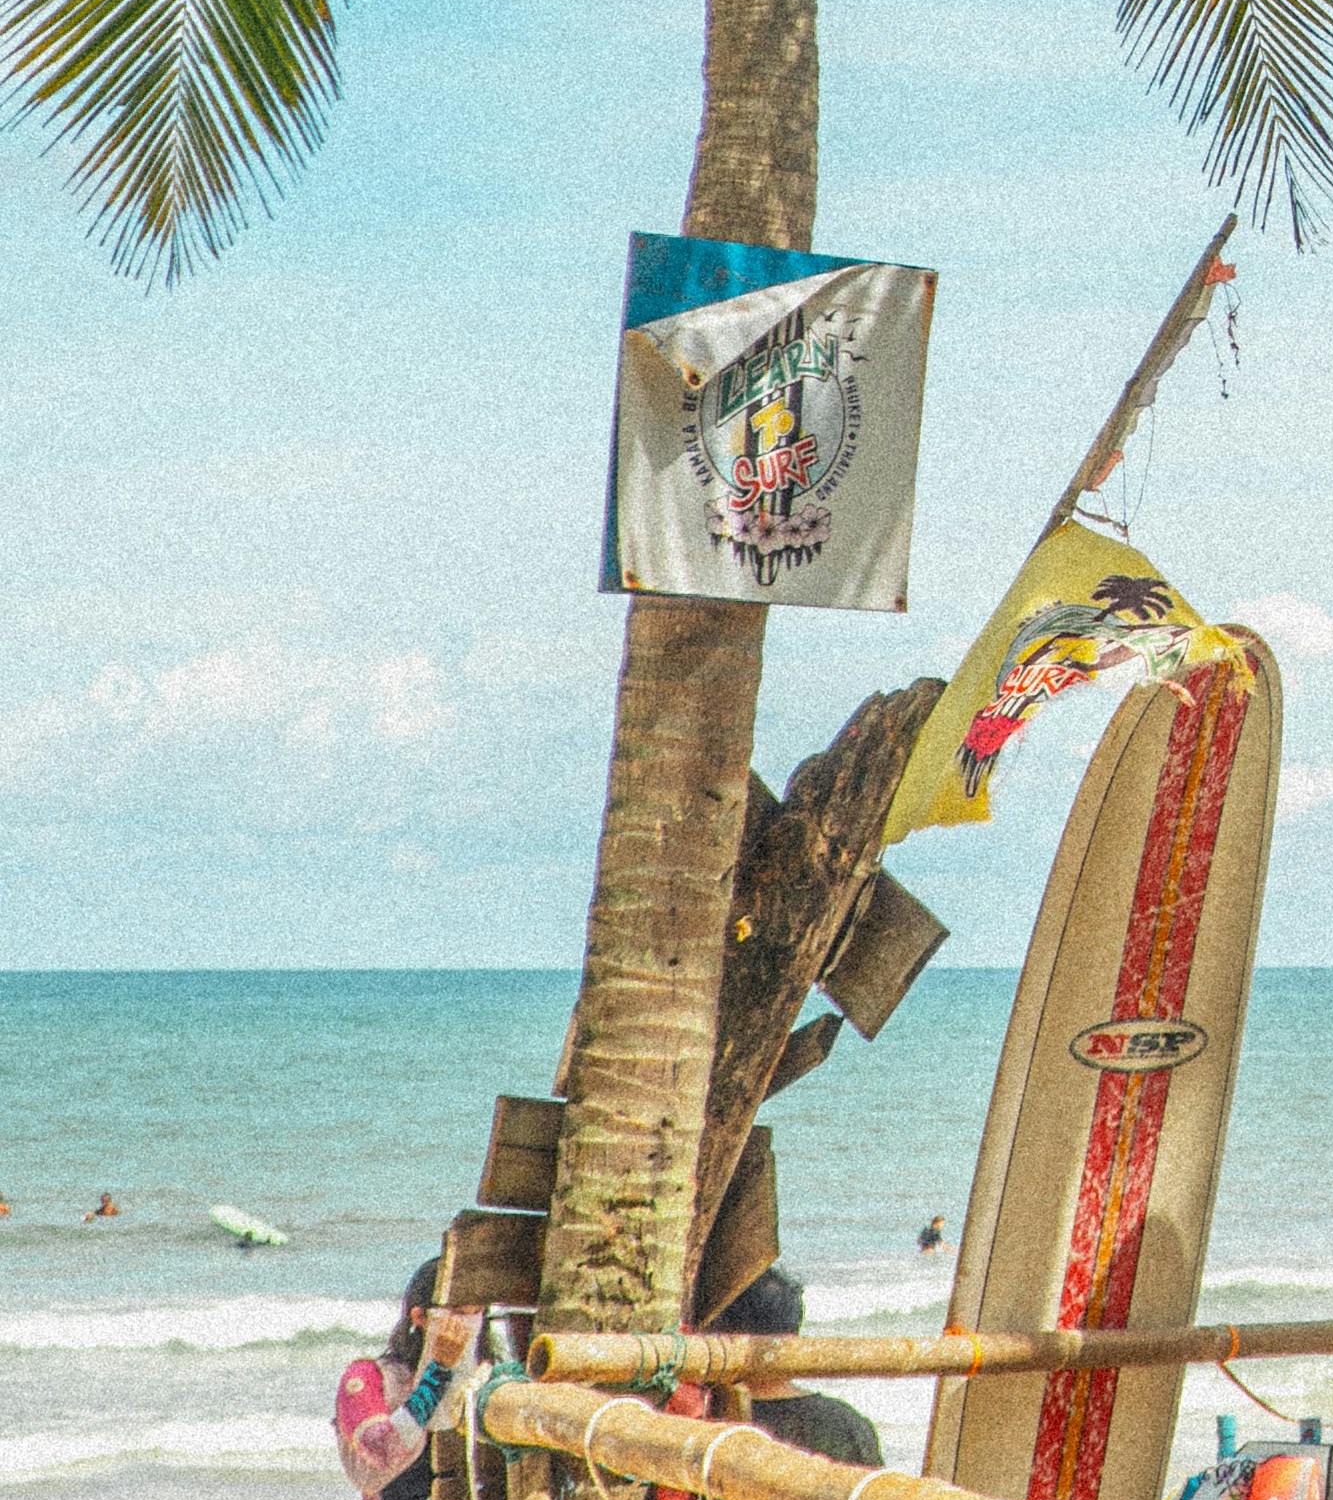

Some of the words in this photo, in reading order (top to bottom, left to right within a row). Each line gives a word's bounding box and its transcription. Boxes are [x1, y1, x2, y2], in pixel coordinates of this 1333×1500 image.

[716, 328, 839, 428] LEARN
[728, 434, 819, 511] SURF
[1086, 1031, 1196, 1055] NSP
